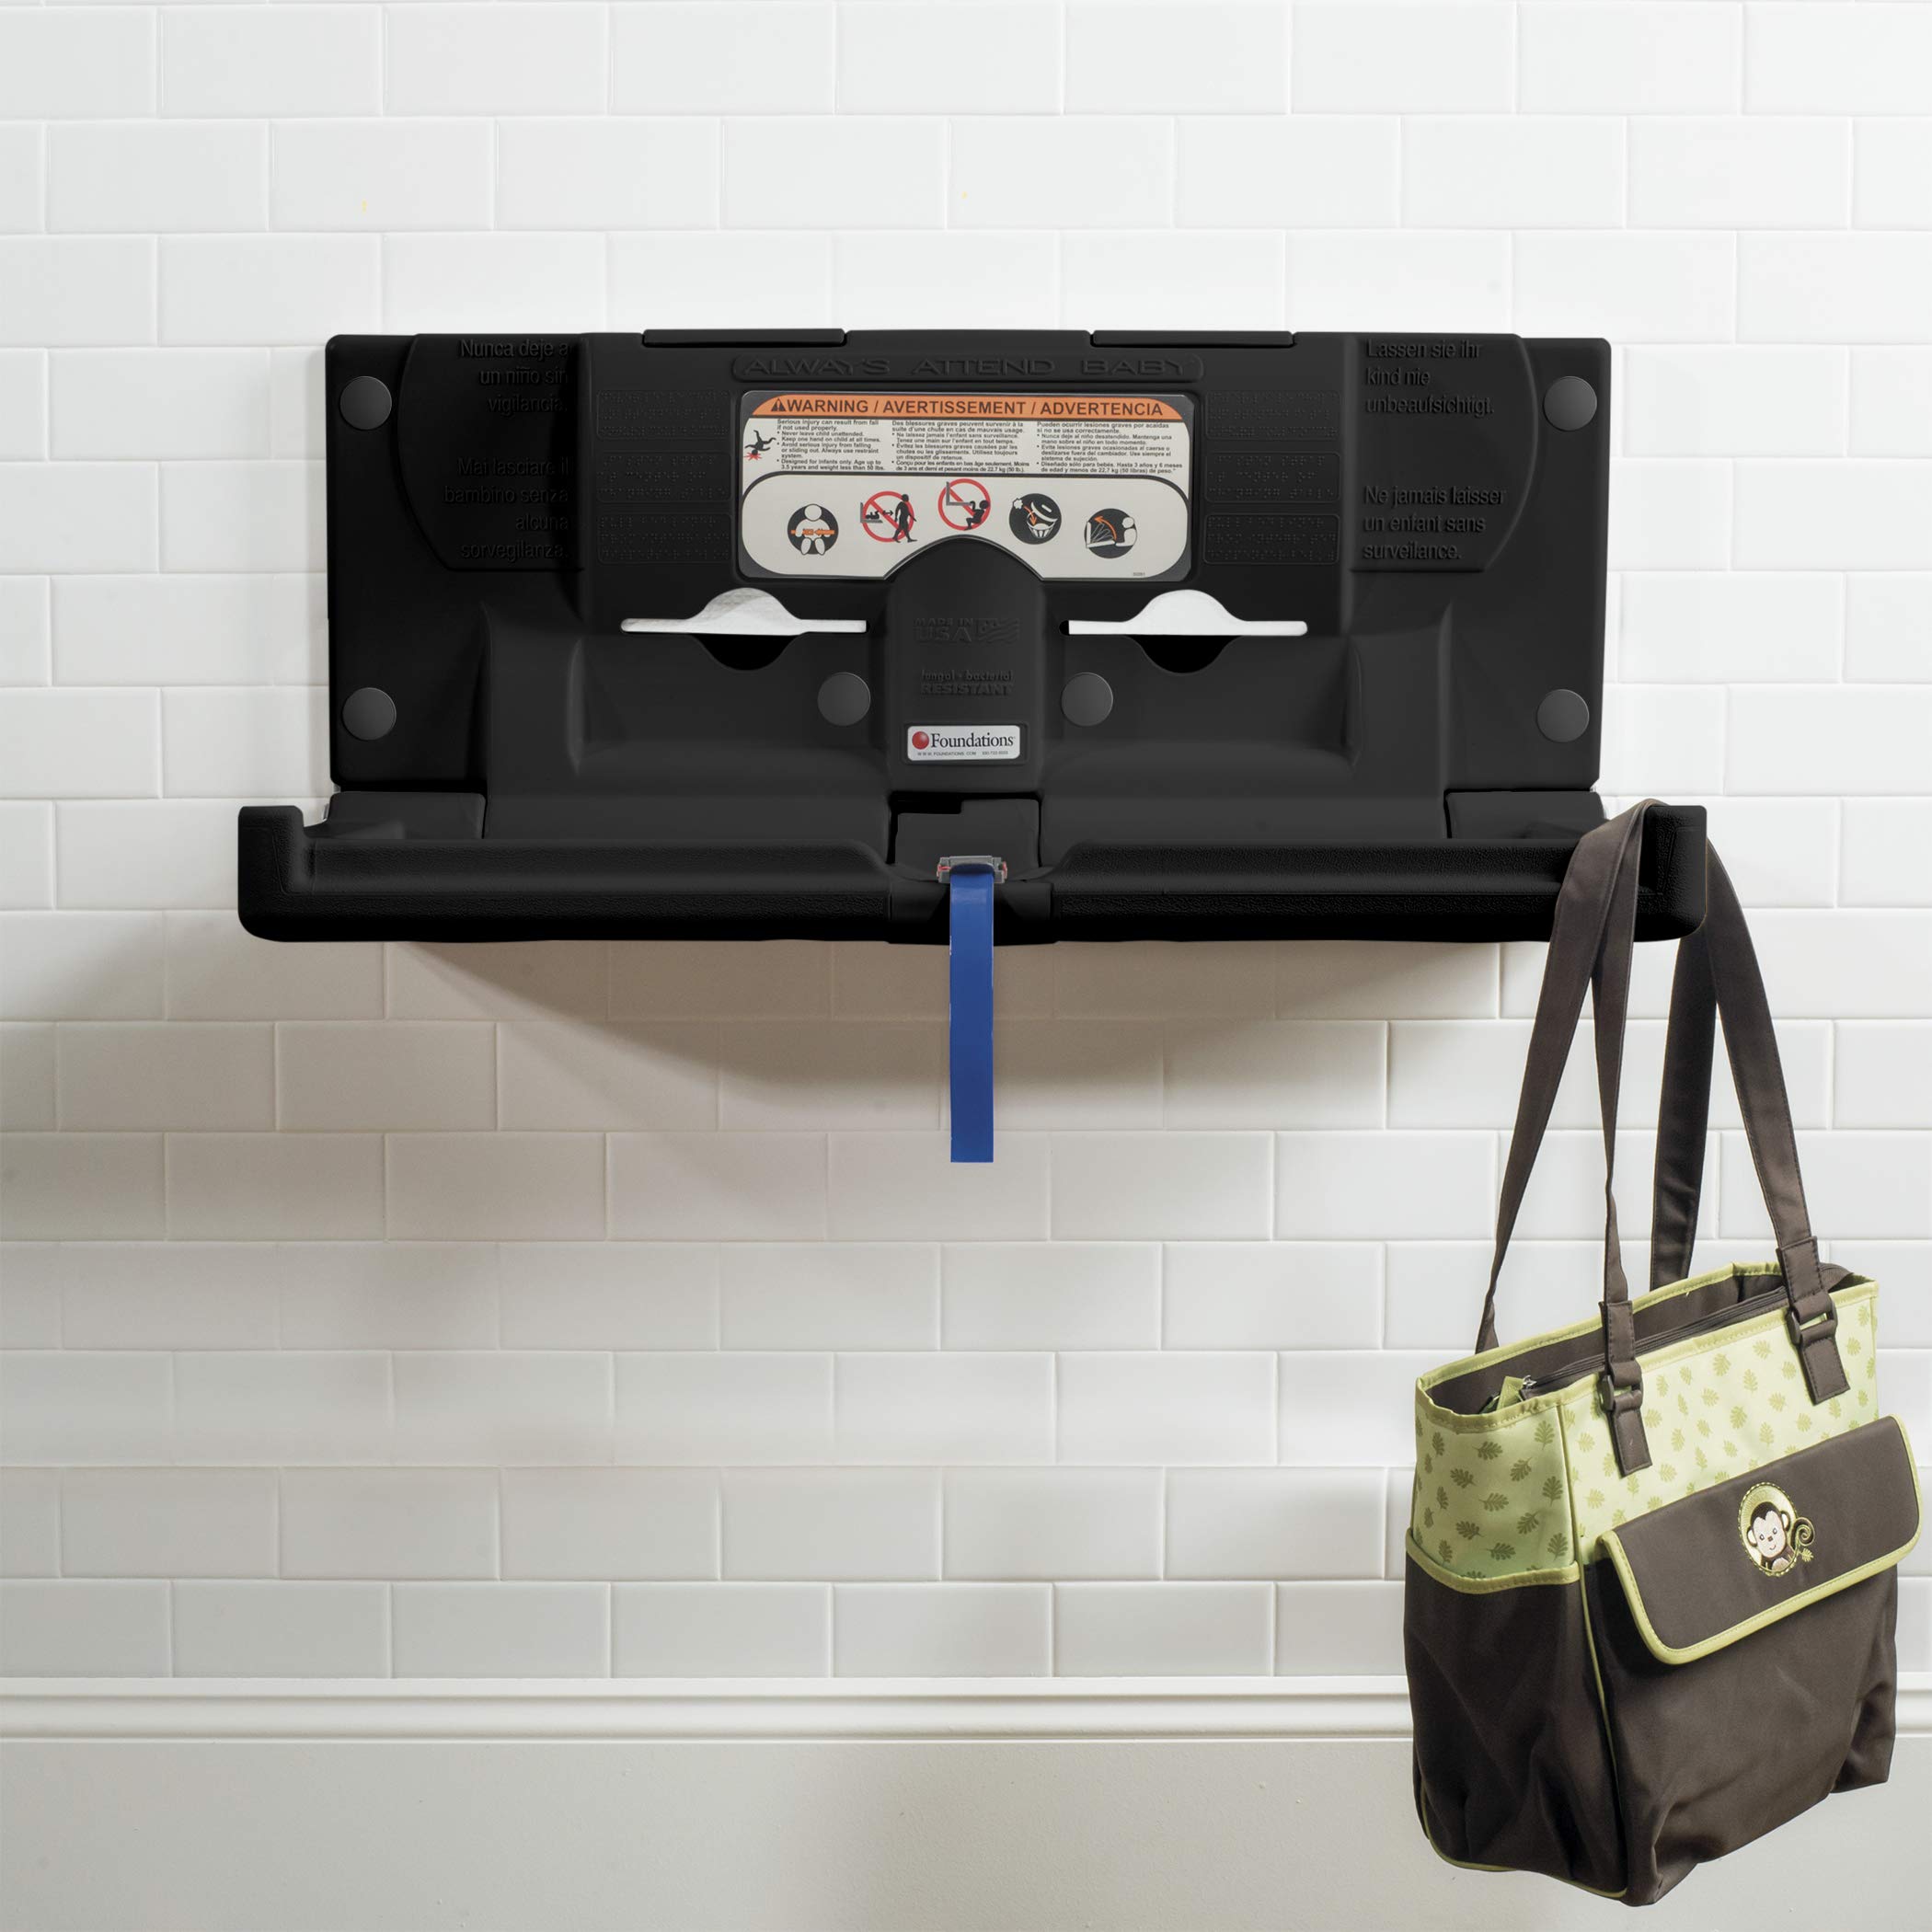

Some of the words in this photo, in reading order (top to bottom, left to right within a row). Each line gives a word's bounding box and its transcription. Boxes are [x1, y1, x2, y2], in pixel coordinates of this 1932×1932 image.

[460, 339, 513, 357] Nunca
[519, 339, 555, 361] deje
[1365, 339, 1427, 358] Lassen
[1431, 339, 1456, 358] sie
[1460, 339, 1480, 358] ihr
[479, 370, 500, 385] un
[505, 366, 540, 385] niño
[545, 367, 568, 385] sin
[742, 359, 891, 377] ALWAYS
[911, 359, 1054, 377] ATTEND
[1080, 359, 1188, 377] BABY
[1365, 368, 1402, 385] kind
[1404, 368, 1431, 385] nie
[787, 399, 868, 412] WARNING
[883, 400, 1026, 414] AVERTISSEMENT
[1041, 402, 1163, 416] ADVERTENCIA
[457, 457, 489, 477] Mai
[443, 486, 516, 504] bambino
[1364, 486, 1387, 505] Ne
[1392, 486, 1447, 508] jamais
[1451, 486, 1504, 505] laisser
[515, 513, 569, 531] alcuna
[1364, 515, 1386, 532] un
[1389, 513, 1443, 532] enfant
[1445, 516, 1487, 533] sans
[913, 627, 972, 642] USA
[920, 683, 1014, 696] RESISTANT
[930, 732, 1014, 748] Foundations
